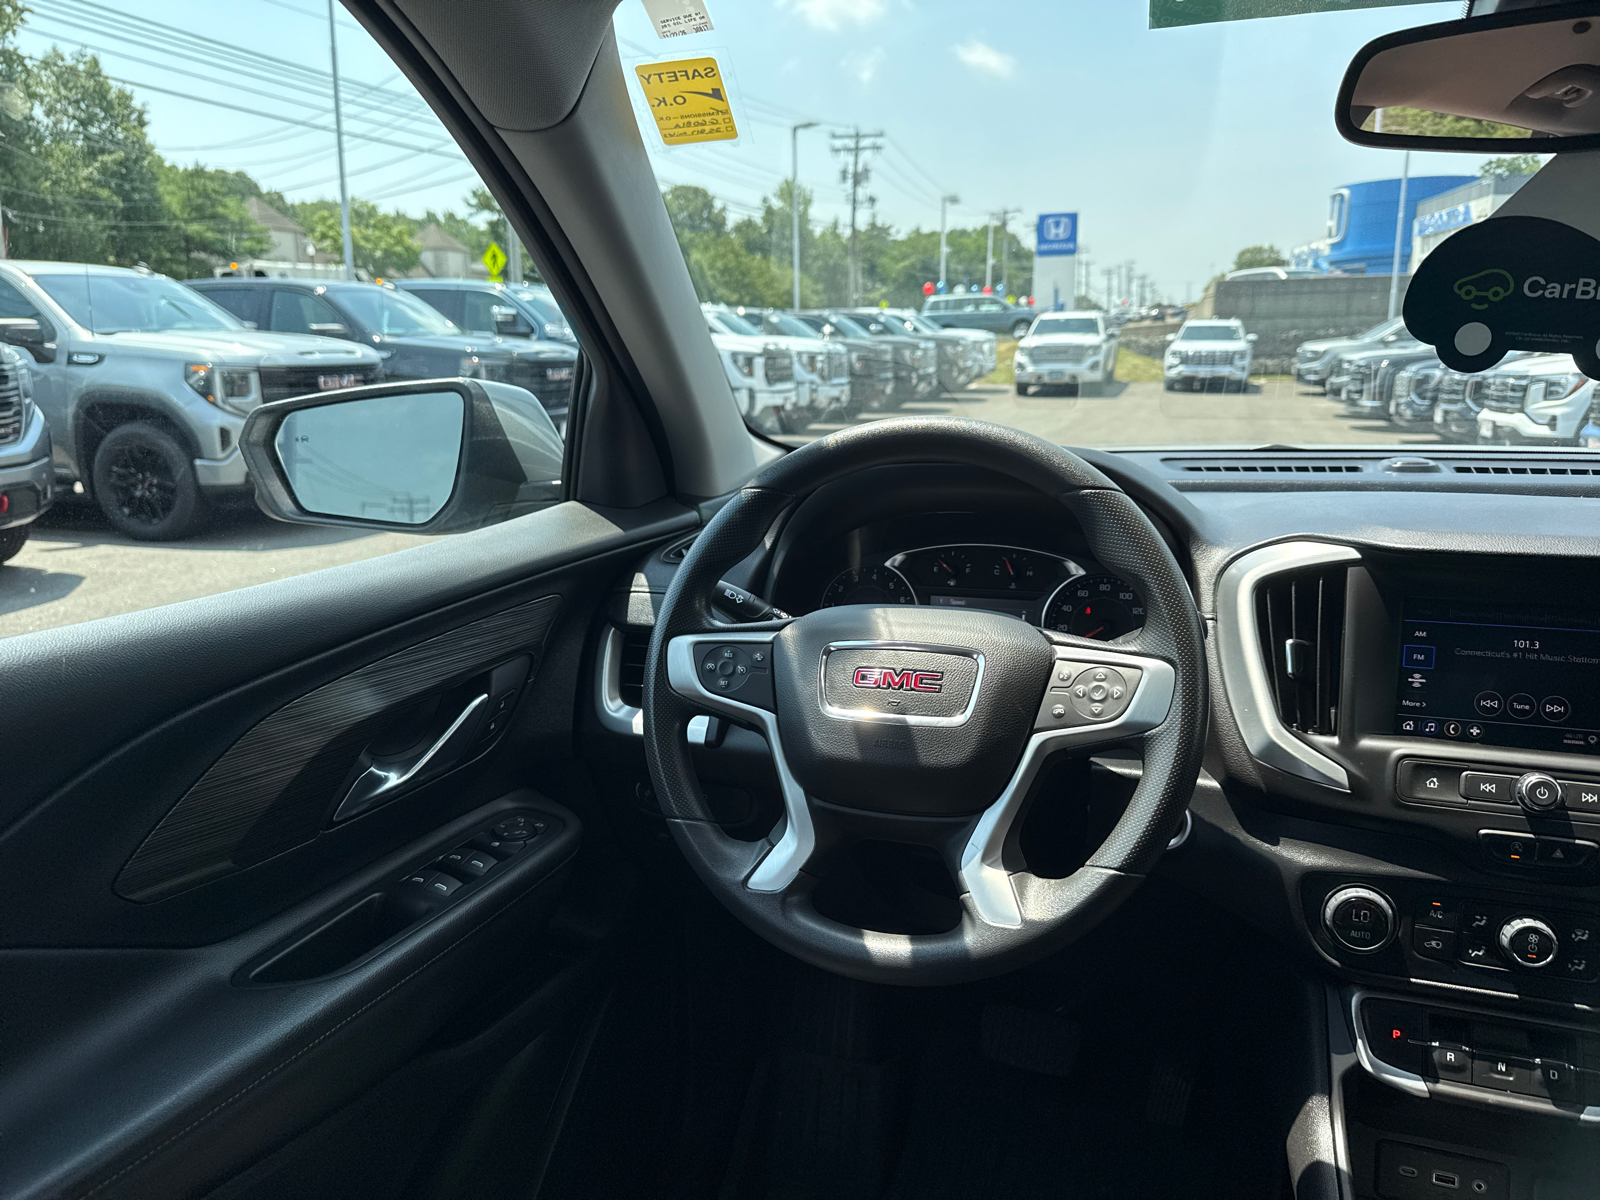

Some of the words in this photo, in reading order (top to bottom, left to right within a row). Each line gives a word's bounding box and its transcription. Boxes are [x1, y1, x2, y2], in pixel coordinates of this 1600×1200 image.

[660, 16, 681, 24] SERVICE
[838, 585, 844, 593] 2
[888, 582, 895, 590] 5
[1099, 583, 1111, 592] 80
[1077, 589, 1089, 598] 60
[1118, 592, 1133, 600] 100
[949, 598, 966, 606] Speed
[1061, 604, 1073, 613] 40
[1056, 623, 1068, 632] 20
[1414, 630, 1427, 638] AM
[1512, 639, 1540, 650] 101.3
[1413, 653, 1425, 661] FM
[1454, 647, 1511, 659] Connecticut's
[1525, 652, 1538, 660] Hit
[1539, 654, 1566, 662] Music
[853, 666, 944, 693] GMC
[1402, 699, 1421, 708] More
[1512, 702, 1530, 711] Tune
[1429, 909, 1444, 919] A/C
[1350, 930, 1371, 940] AUTO
[1392, 1029, 1401, 1039] P
[1446, 1051, 1455, 1062] R
[1497, 1062, 1506, 1072] N
[1549, 1069, 1558, 1080] D
